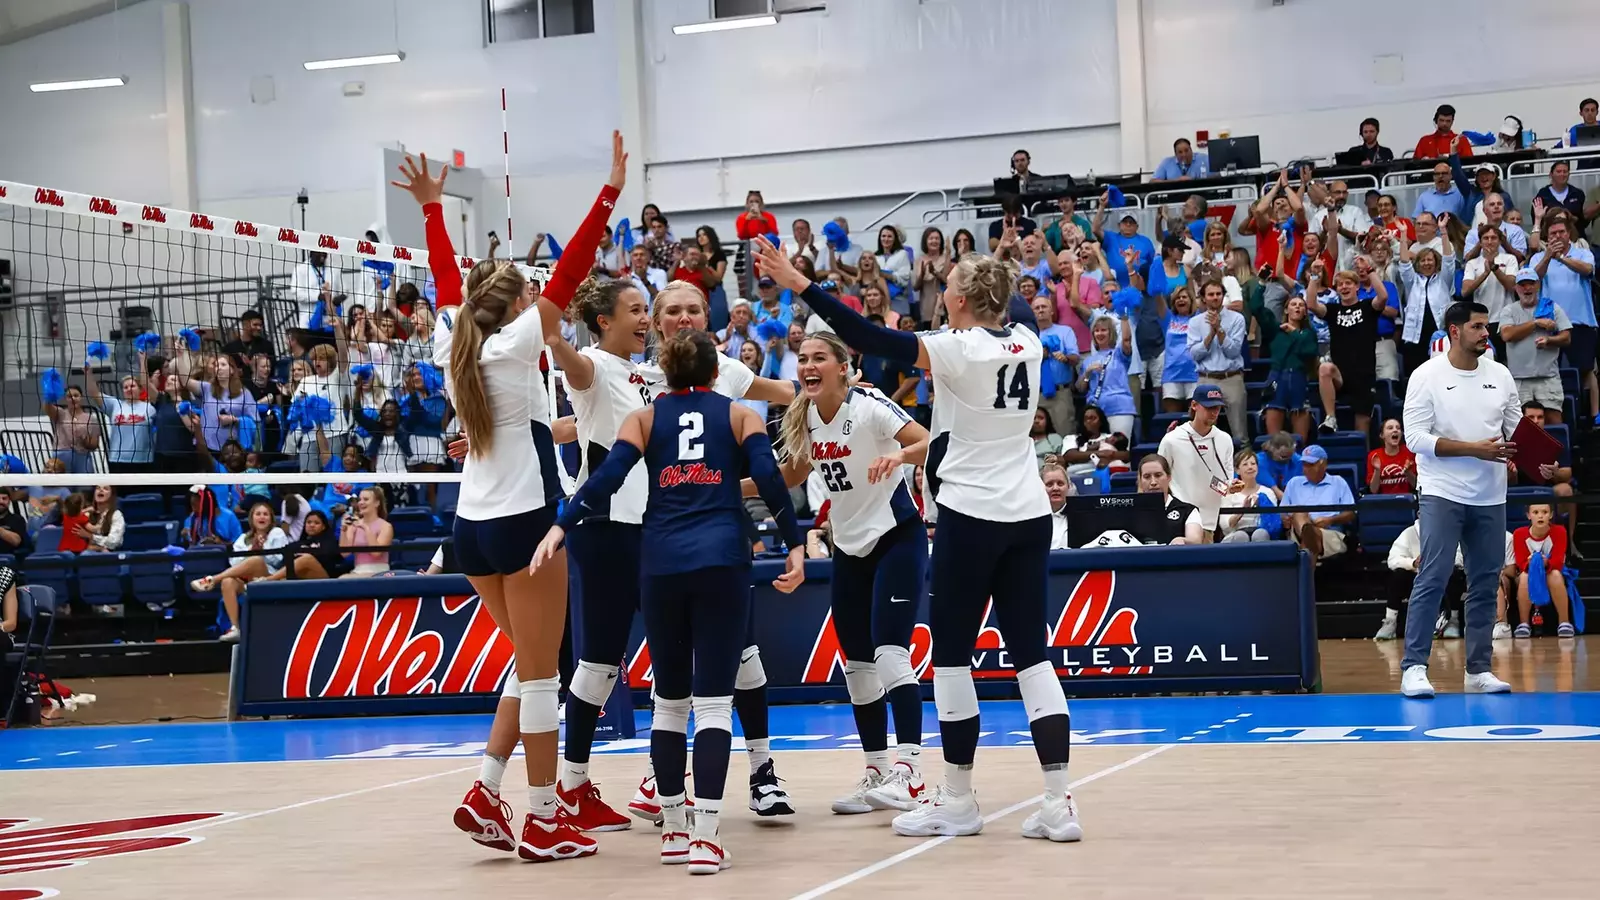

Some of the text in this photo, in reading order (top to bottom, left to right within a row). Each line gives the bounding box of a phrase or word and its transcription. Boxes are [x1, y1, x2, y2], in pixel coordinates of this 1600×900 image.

[993, 361, 1030, 410] 14
[678, 411, 704, 461] 2
[812, 441, 852, 460] Ole Miss
[660, 463, 722, 488] Ole Miss
[820, 461, 853, 492] 22
[283, 596, 443, 698] Ole
[971, 643, 1269, 669] VOLEYBALL
